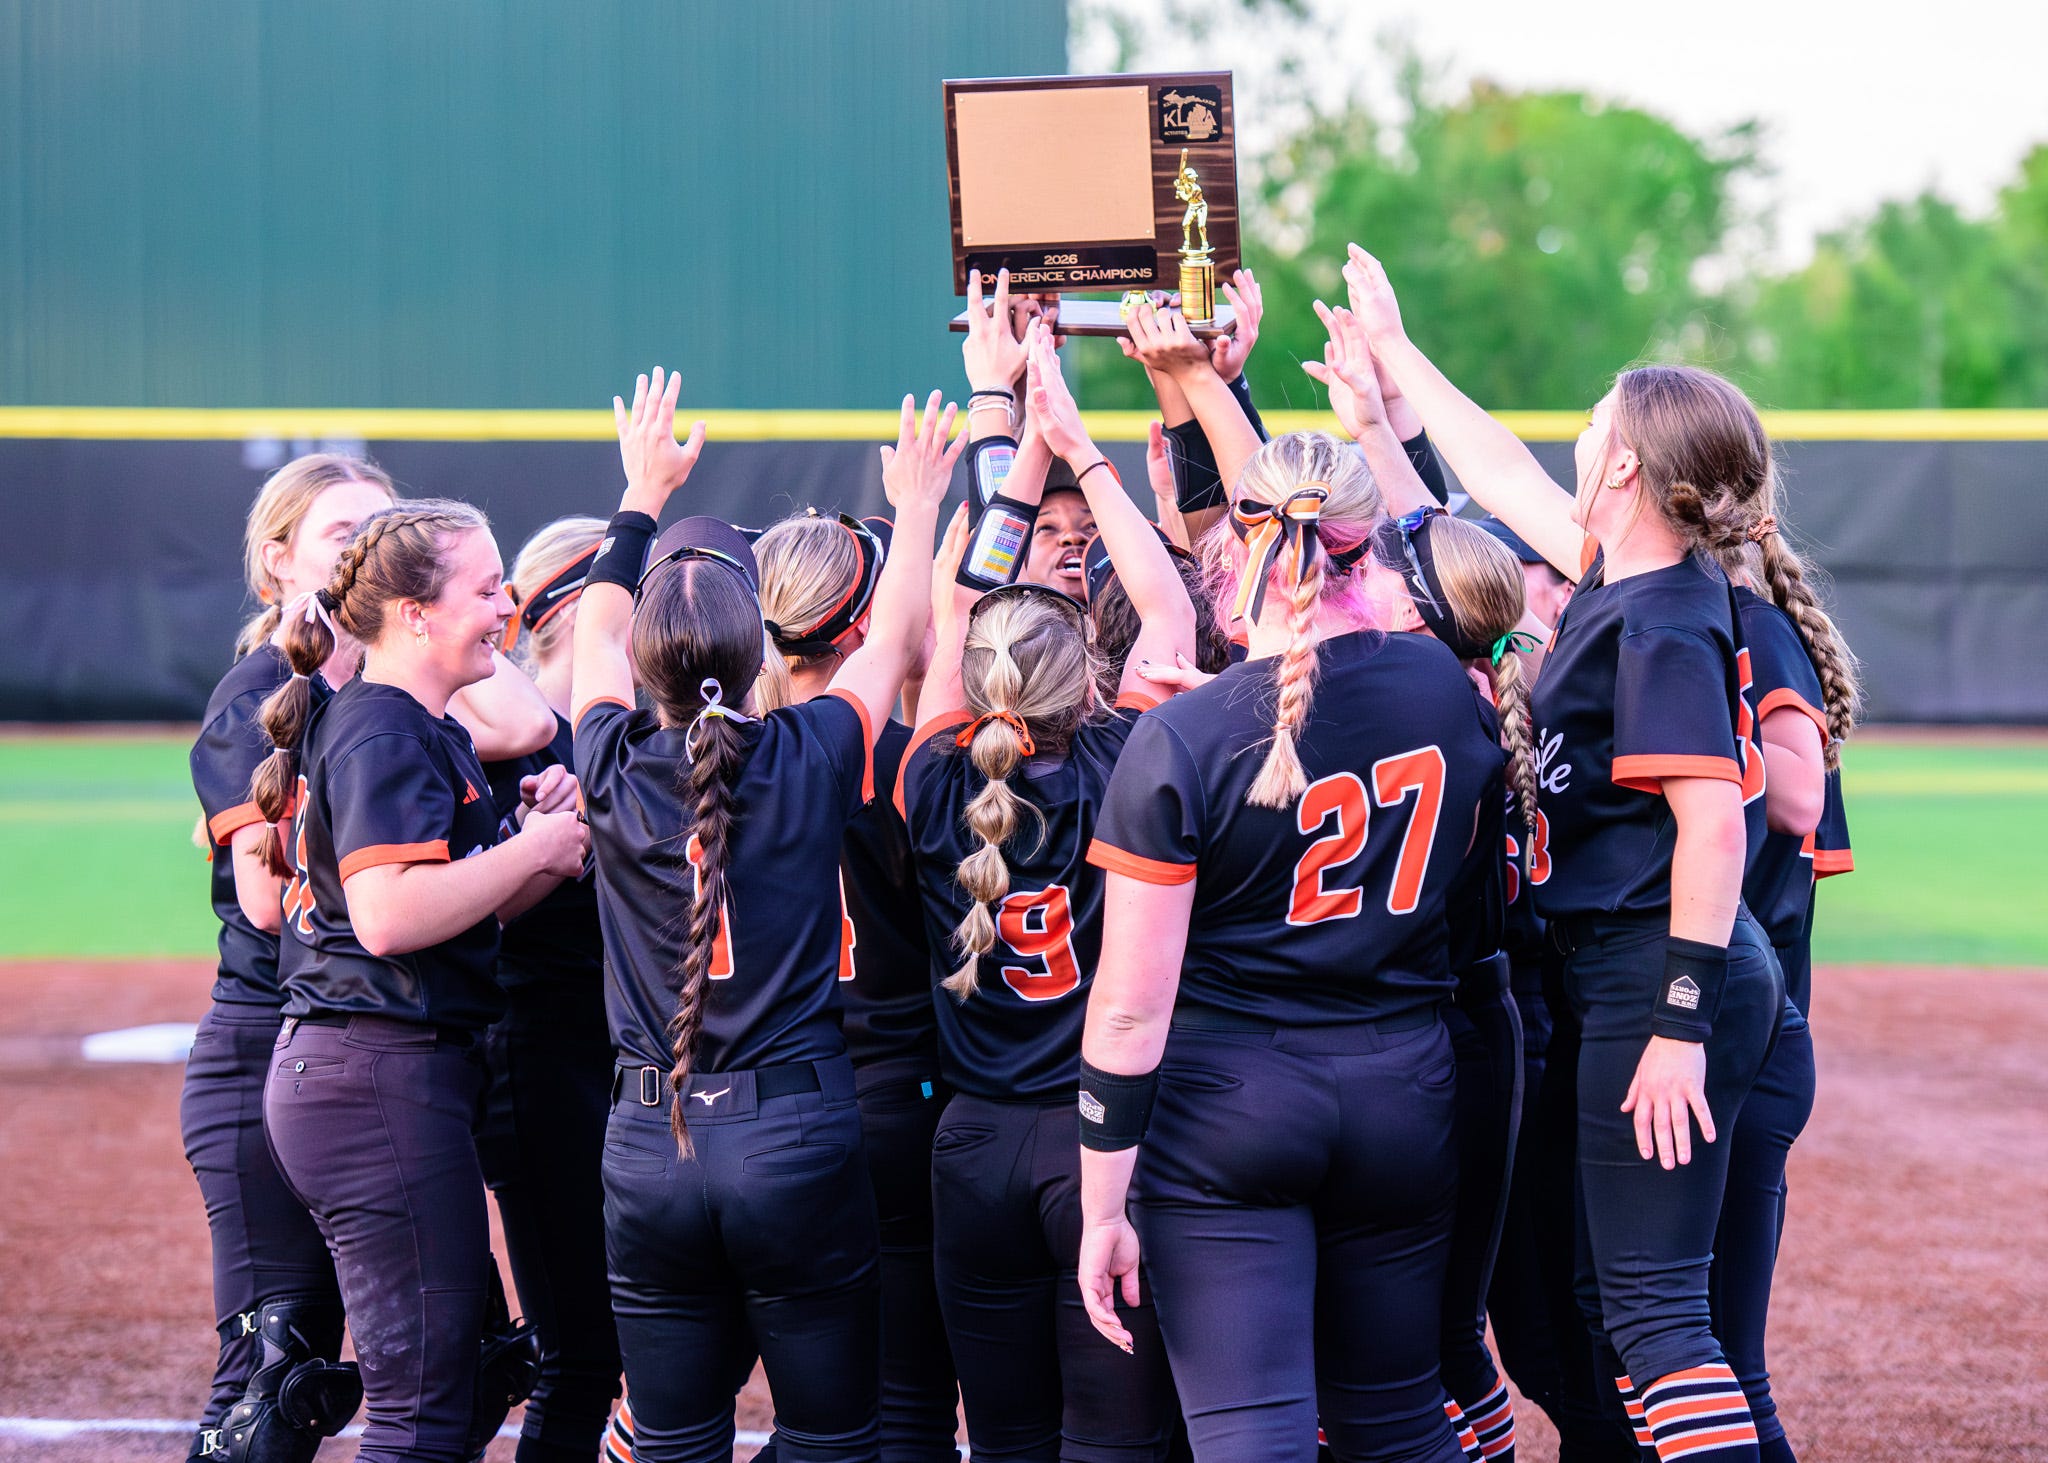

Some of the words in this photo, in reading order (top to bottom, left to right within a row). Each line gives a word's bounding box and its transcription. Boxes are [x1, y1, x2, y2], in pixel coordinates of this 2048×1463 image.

[1163, 107, 1217, 128] KLA
[1043, 253, 1079, 266] 2026
[980, 271, 1065, 285] ONERENCE
[1070, 268, 1153, 281] CHAMPIONS
[1285, 744, 1446, 926] 27
[995, 883, 1081, 1001] 9
[1668, 991, 1698, 1003] ZONE
